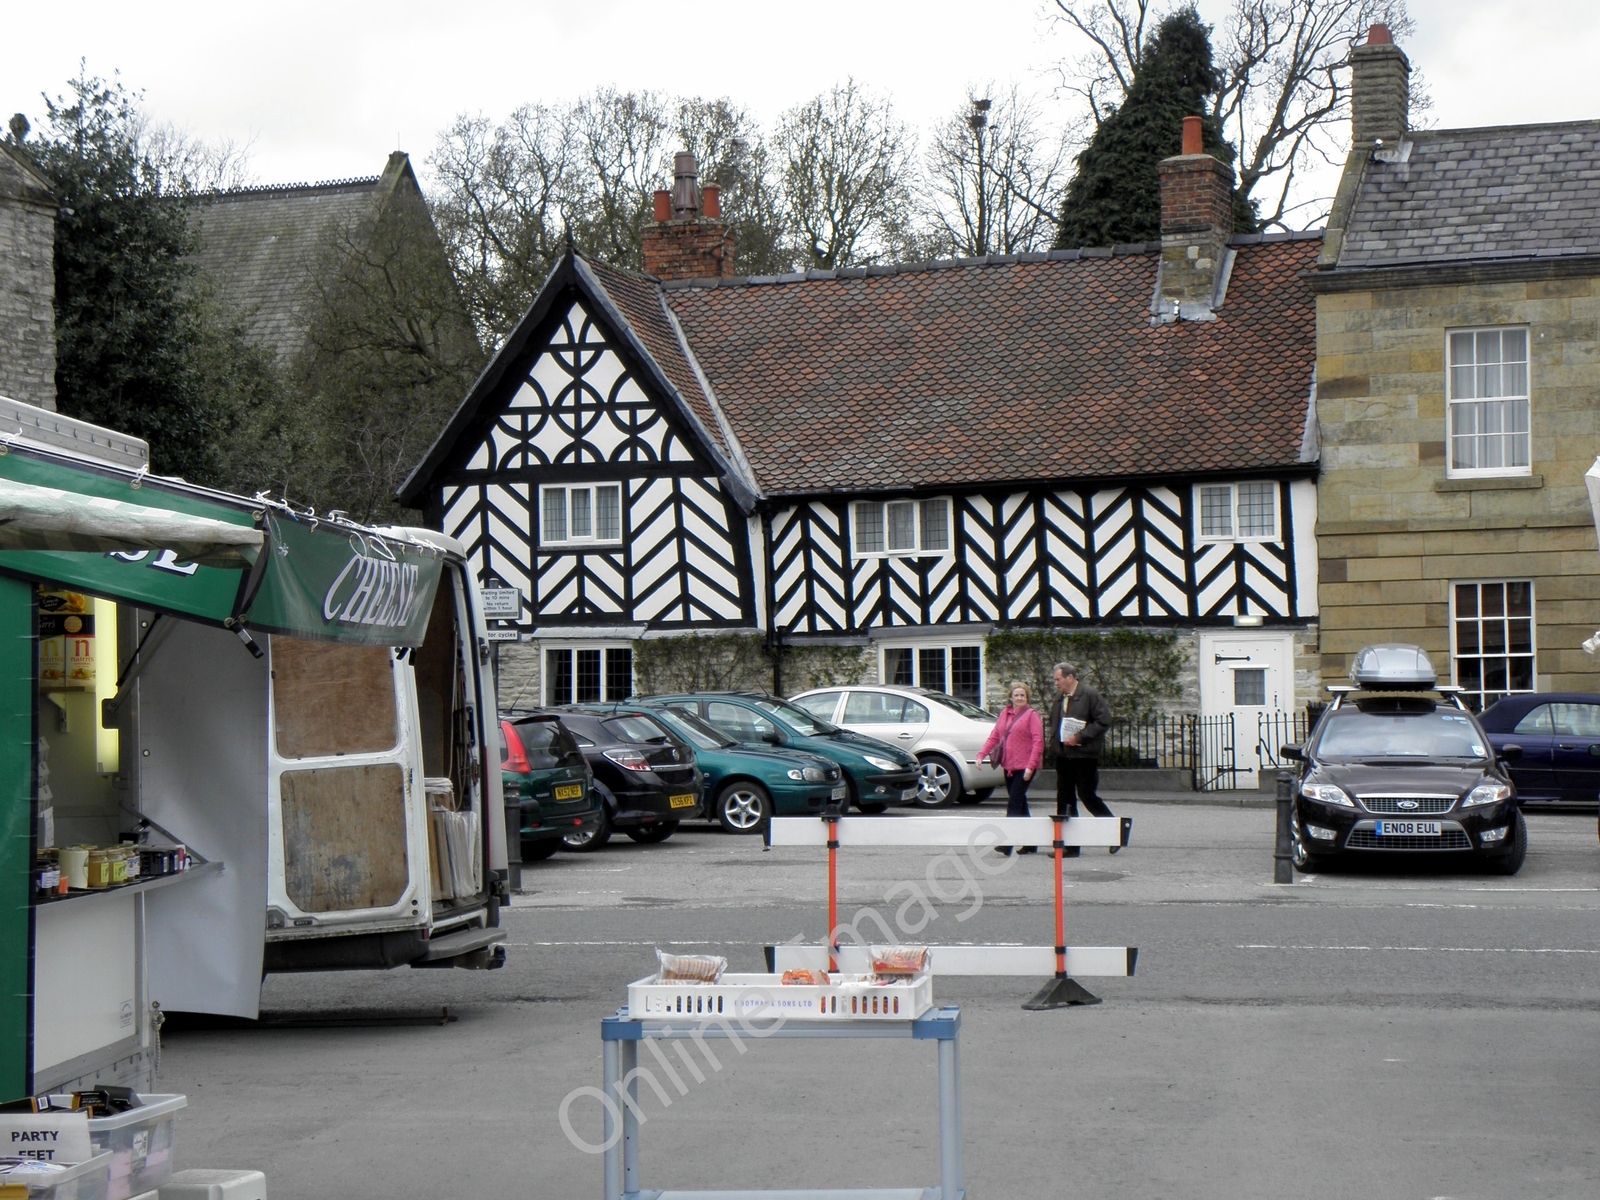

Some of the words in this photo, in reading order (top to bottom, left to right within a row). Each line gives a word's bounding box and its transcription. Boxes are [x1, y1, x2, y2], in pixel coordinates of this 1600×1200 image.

[324, 553, 419, 628] CHEESE
[75, 640, 90, 657] n
[1383, 823, 1414, 834] EN08
[1416, 823, 1439, 834] EUL
[777, 1000, 796, 1008] SONS
[798, 1000, 813, 1008] LTD
[11, 1131, 59, 1142] PARTY
[18, 1150, 56, 1161] FEET
